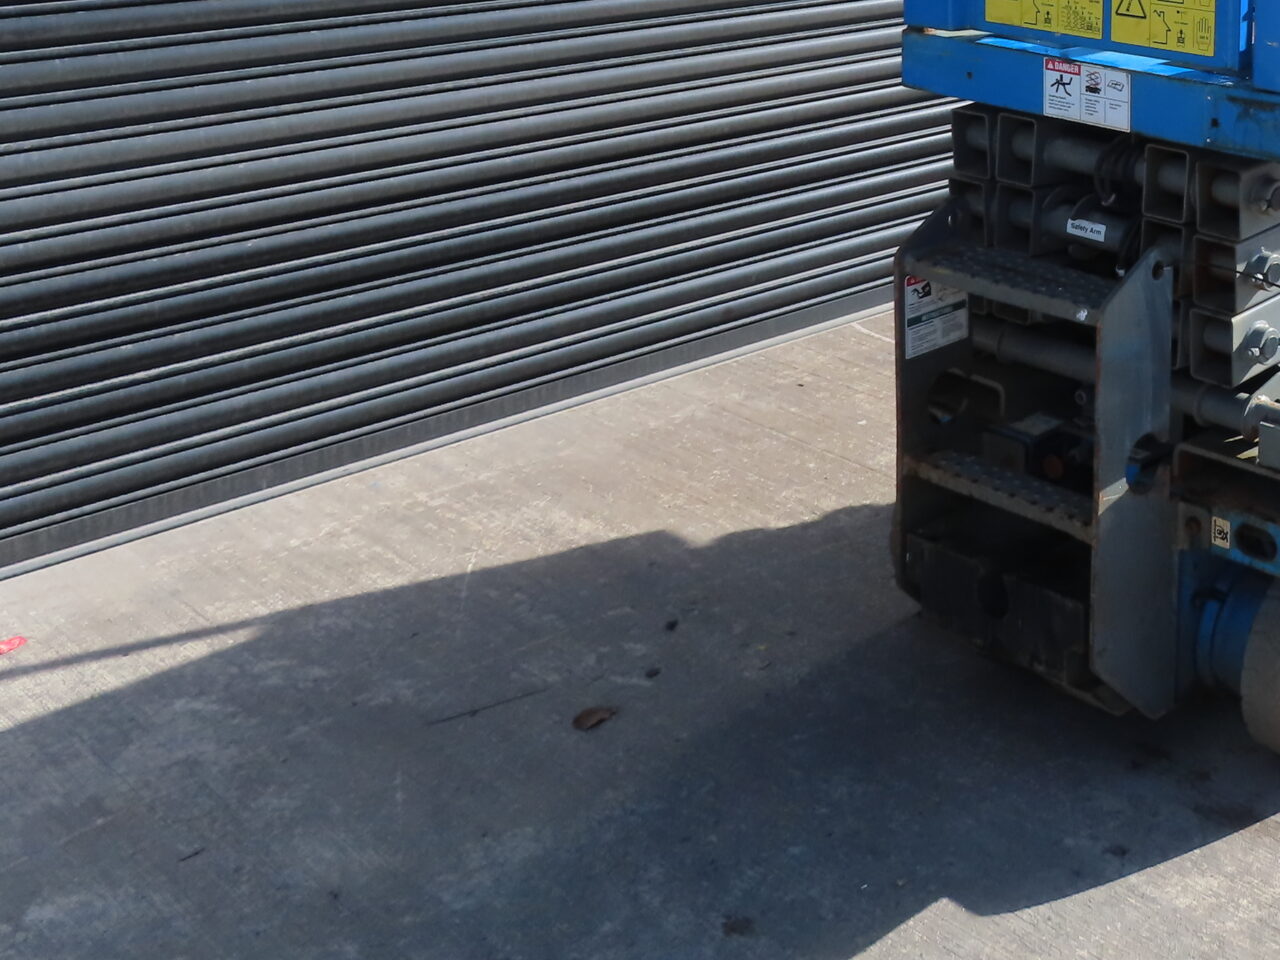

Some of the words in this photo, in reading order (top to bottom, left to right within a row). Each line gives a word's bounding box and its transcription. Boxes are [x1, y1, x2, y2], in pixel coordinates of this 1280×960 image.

[1054, 60, 1079, 73] DANGER
[1071, 222, 1089, 233] Safety
[1089, 227, 1102, 235] Arm
